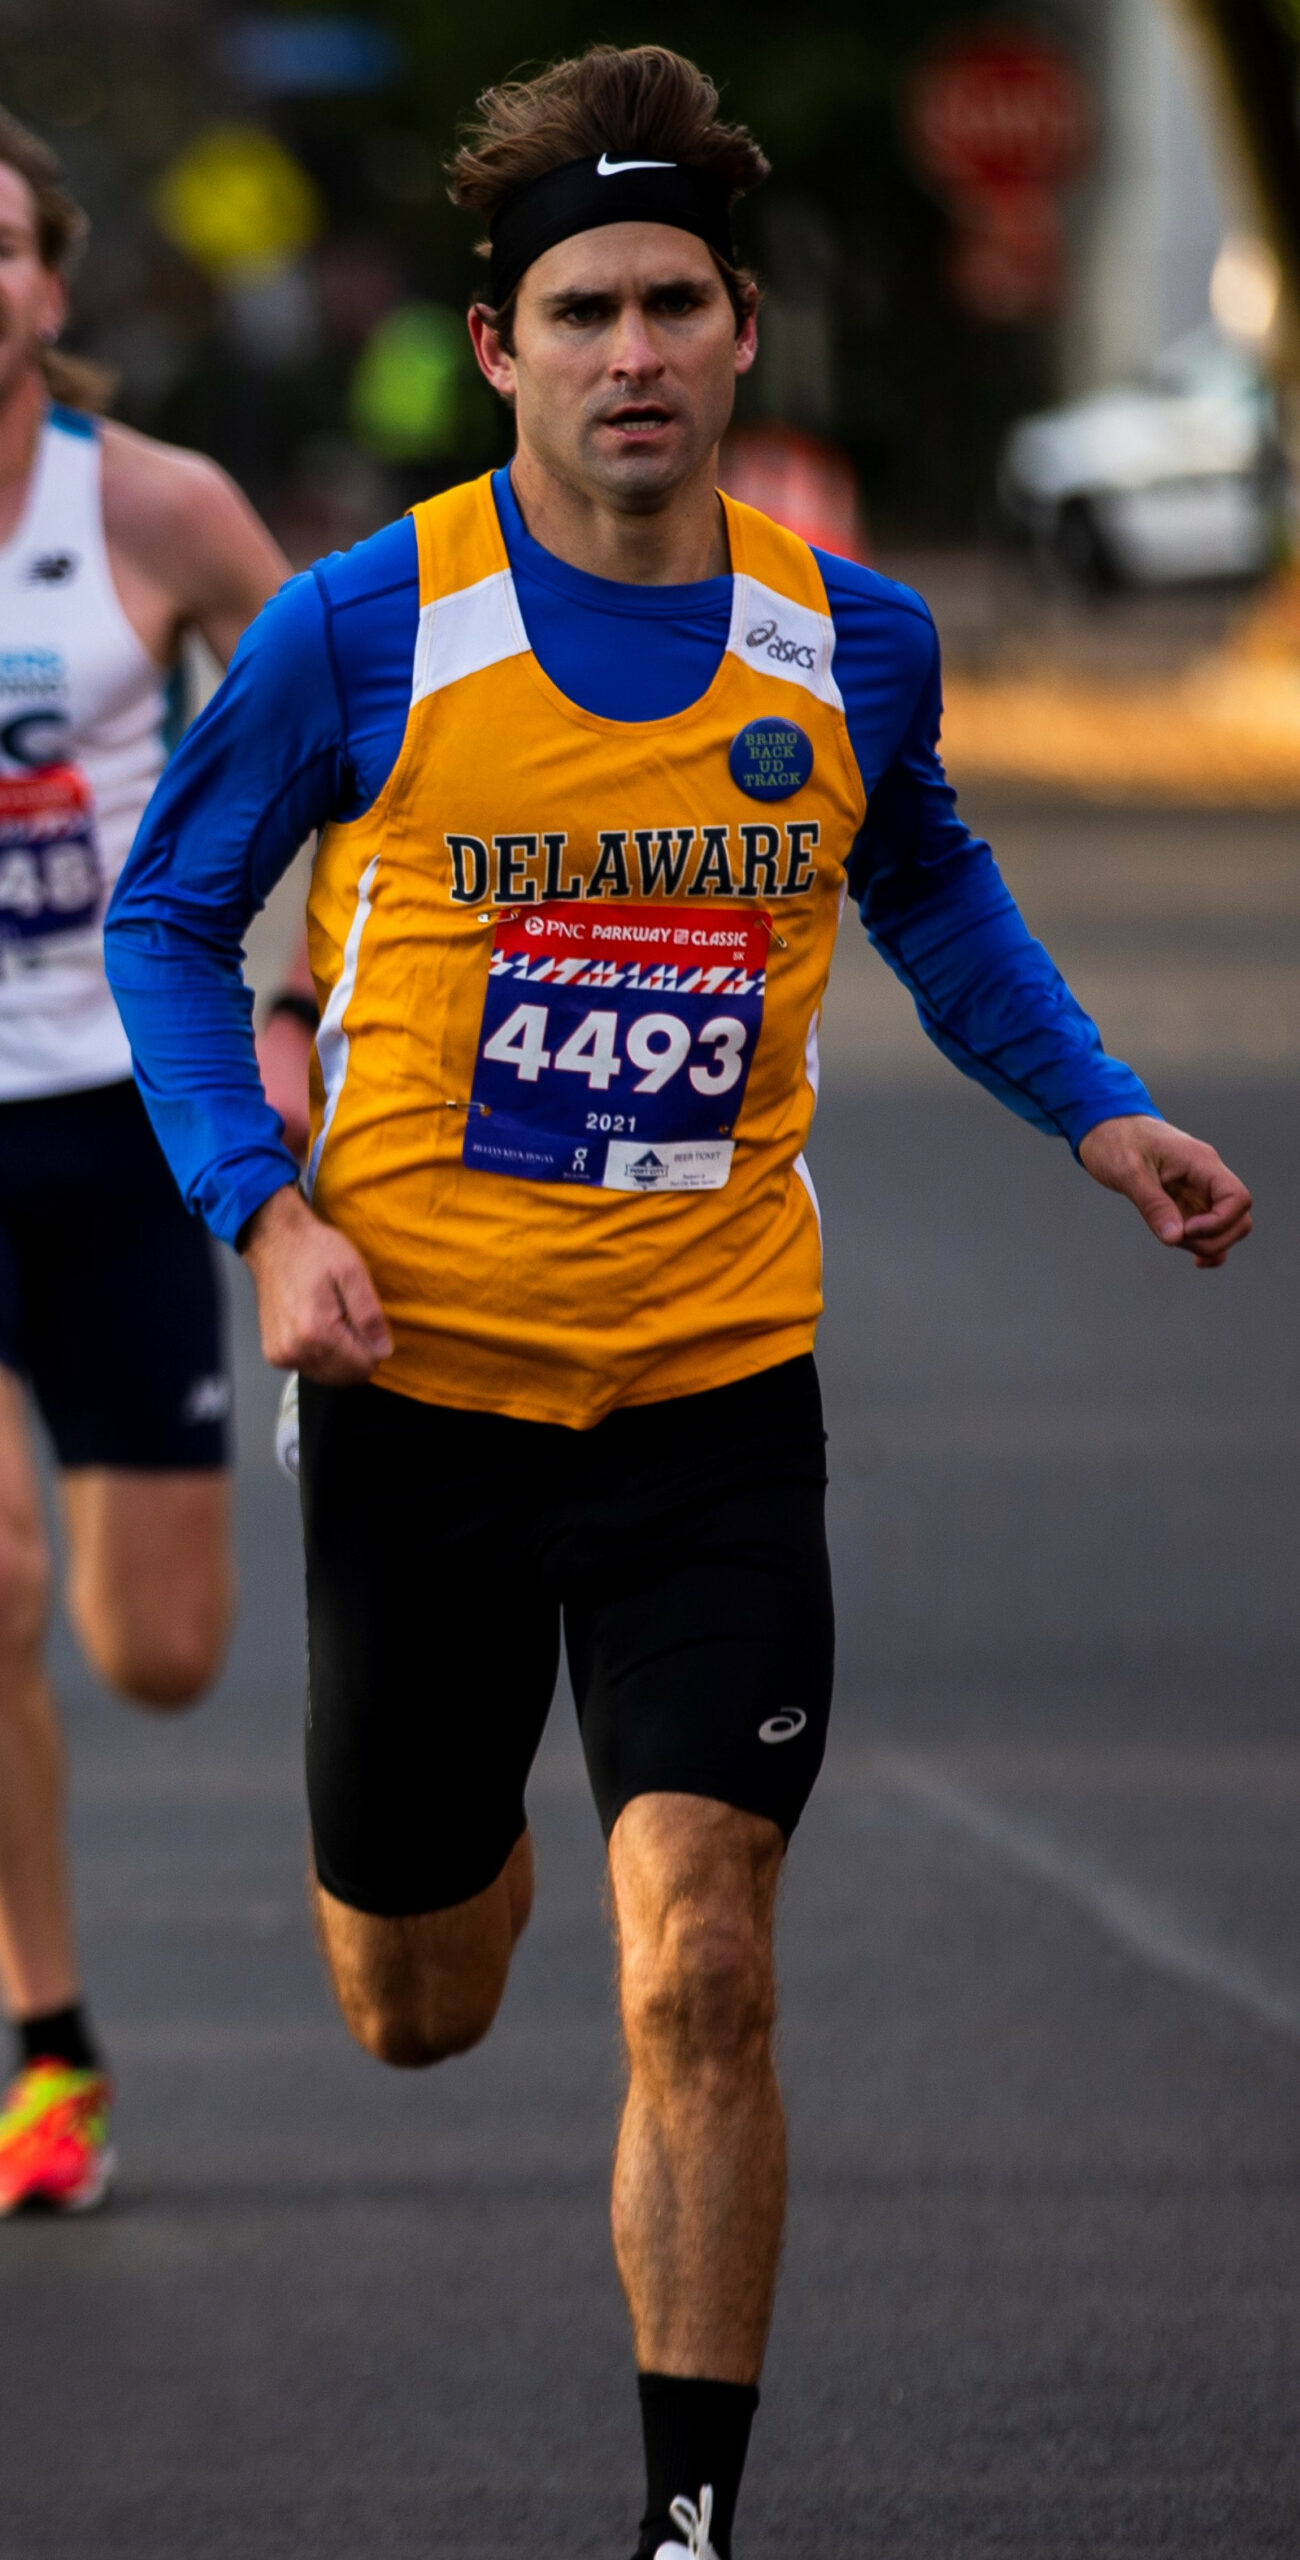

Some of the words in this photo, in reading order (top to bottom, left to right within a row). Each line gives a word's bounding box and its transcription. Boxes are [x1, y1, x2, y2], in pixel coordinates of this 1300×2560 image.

[766, 636, 817, 672] asics
[744, 732, 798, 747] BRING
[749, 745, 795, 759] BACK
[759, 760, 785, 773] UD
[744, 772, 801, 786] TRACK
[445, 820, 820, 904] DELAWARE
[547, 919, 587, 940] PNC
[591, 924, 672, 943] PARKWAY
[690, 930, 749, 947] CLASSIC
[483, 1003, 748, 1096] 4493
[585, 1113, 637, 1132] 2021
